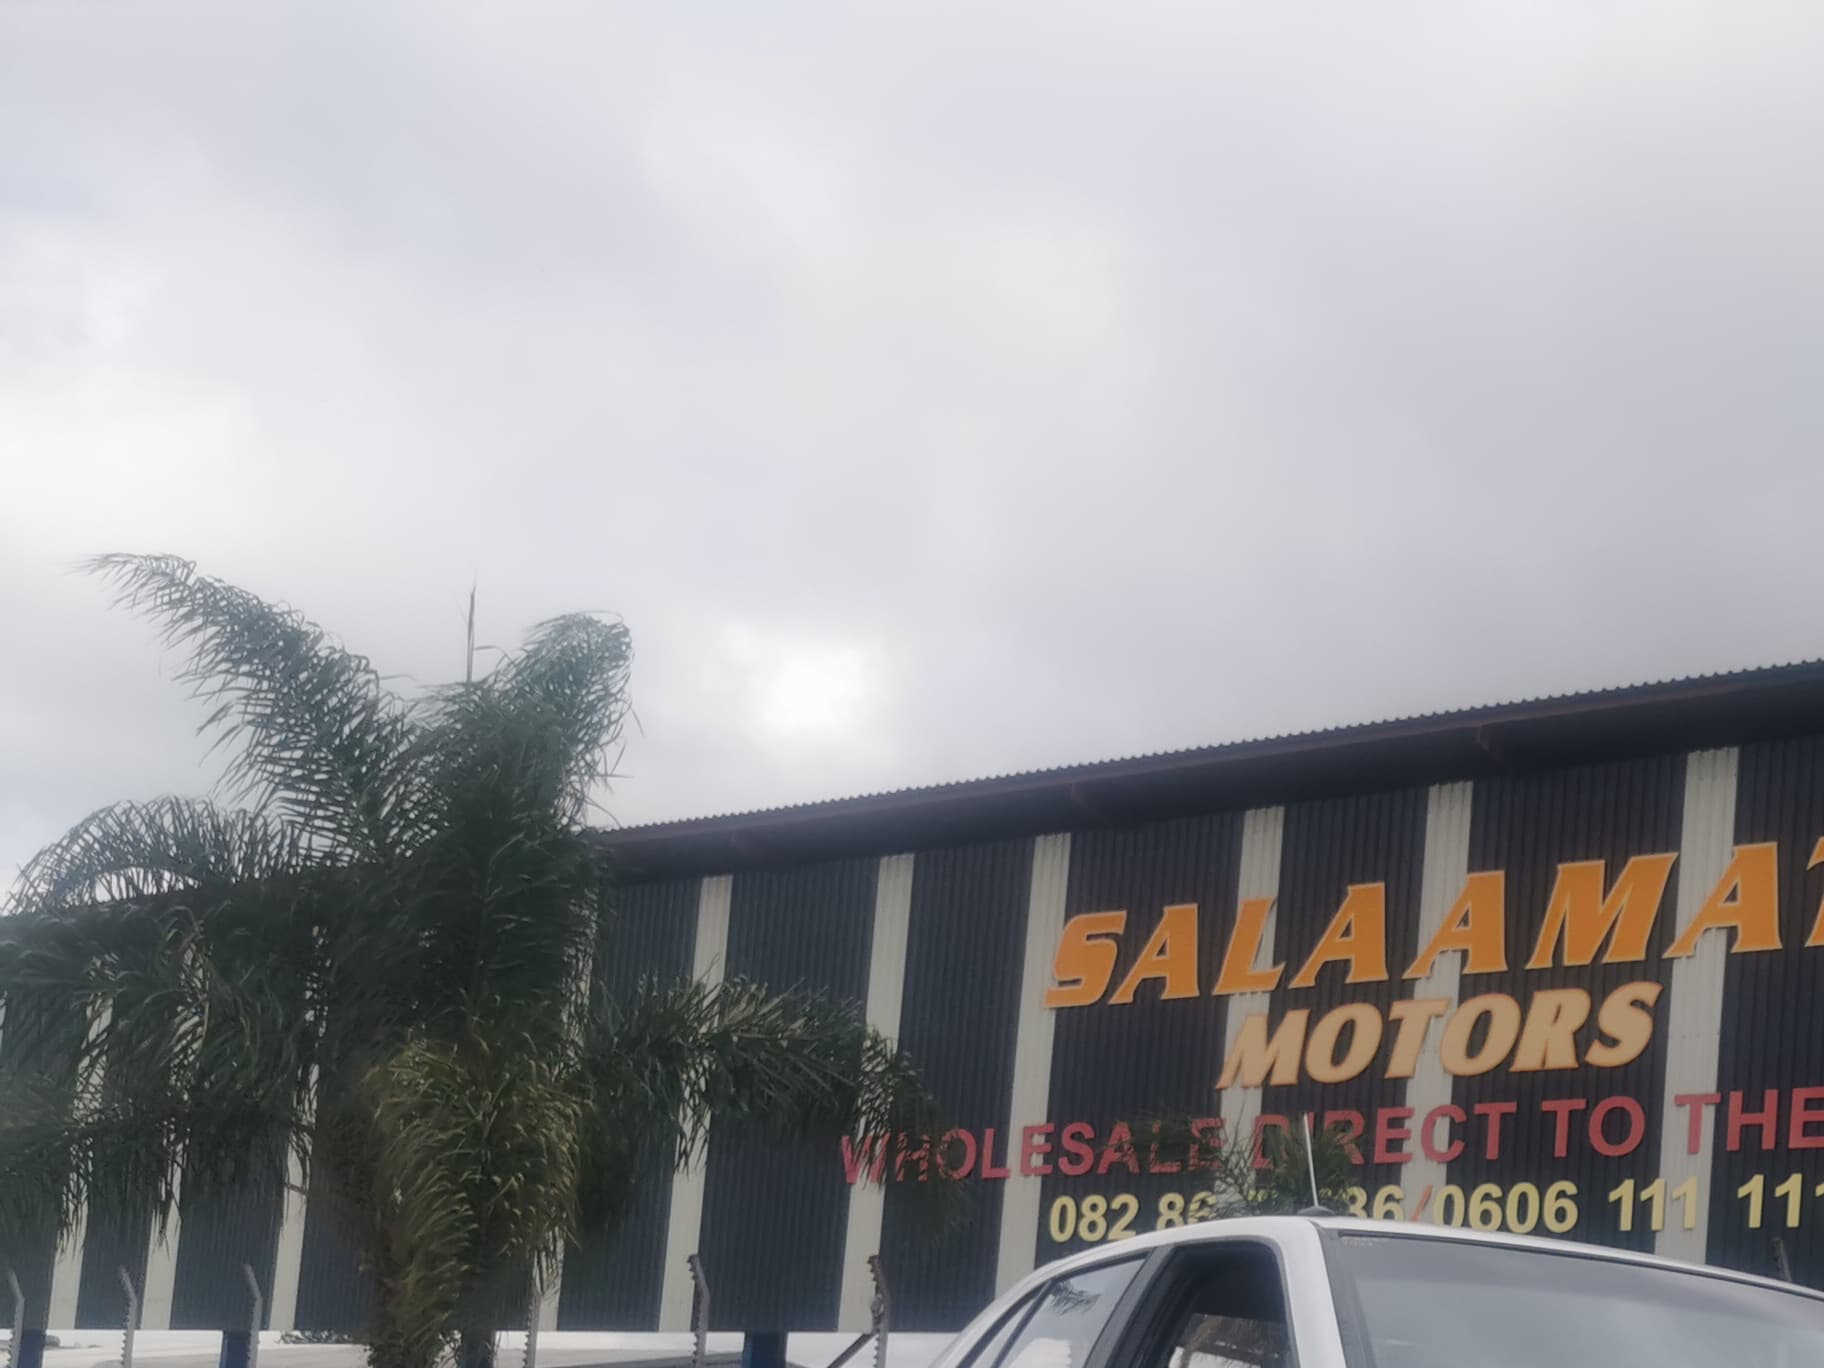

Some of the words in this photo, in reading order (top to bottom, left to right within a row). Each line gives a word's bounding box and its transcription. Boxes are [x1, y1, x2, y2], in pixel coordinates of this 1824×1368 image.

[1216, 981, 1664, 1090] MOTORS
[840, 1116, 1226, 1184] WHOLESALE
[1541, 1095, 1645, 1158] TO
[1048, 1193, 1139, 1243] 082
[1608, 1176, 1698, 1232] 111
